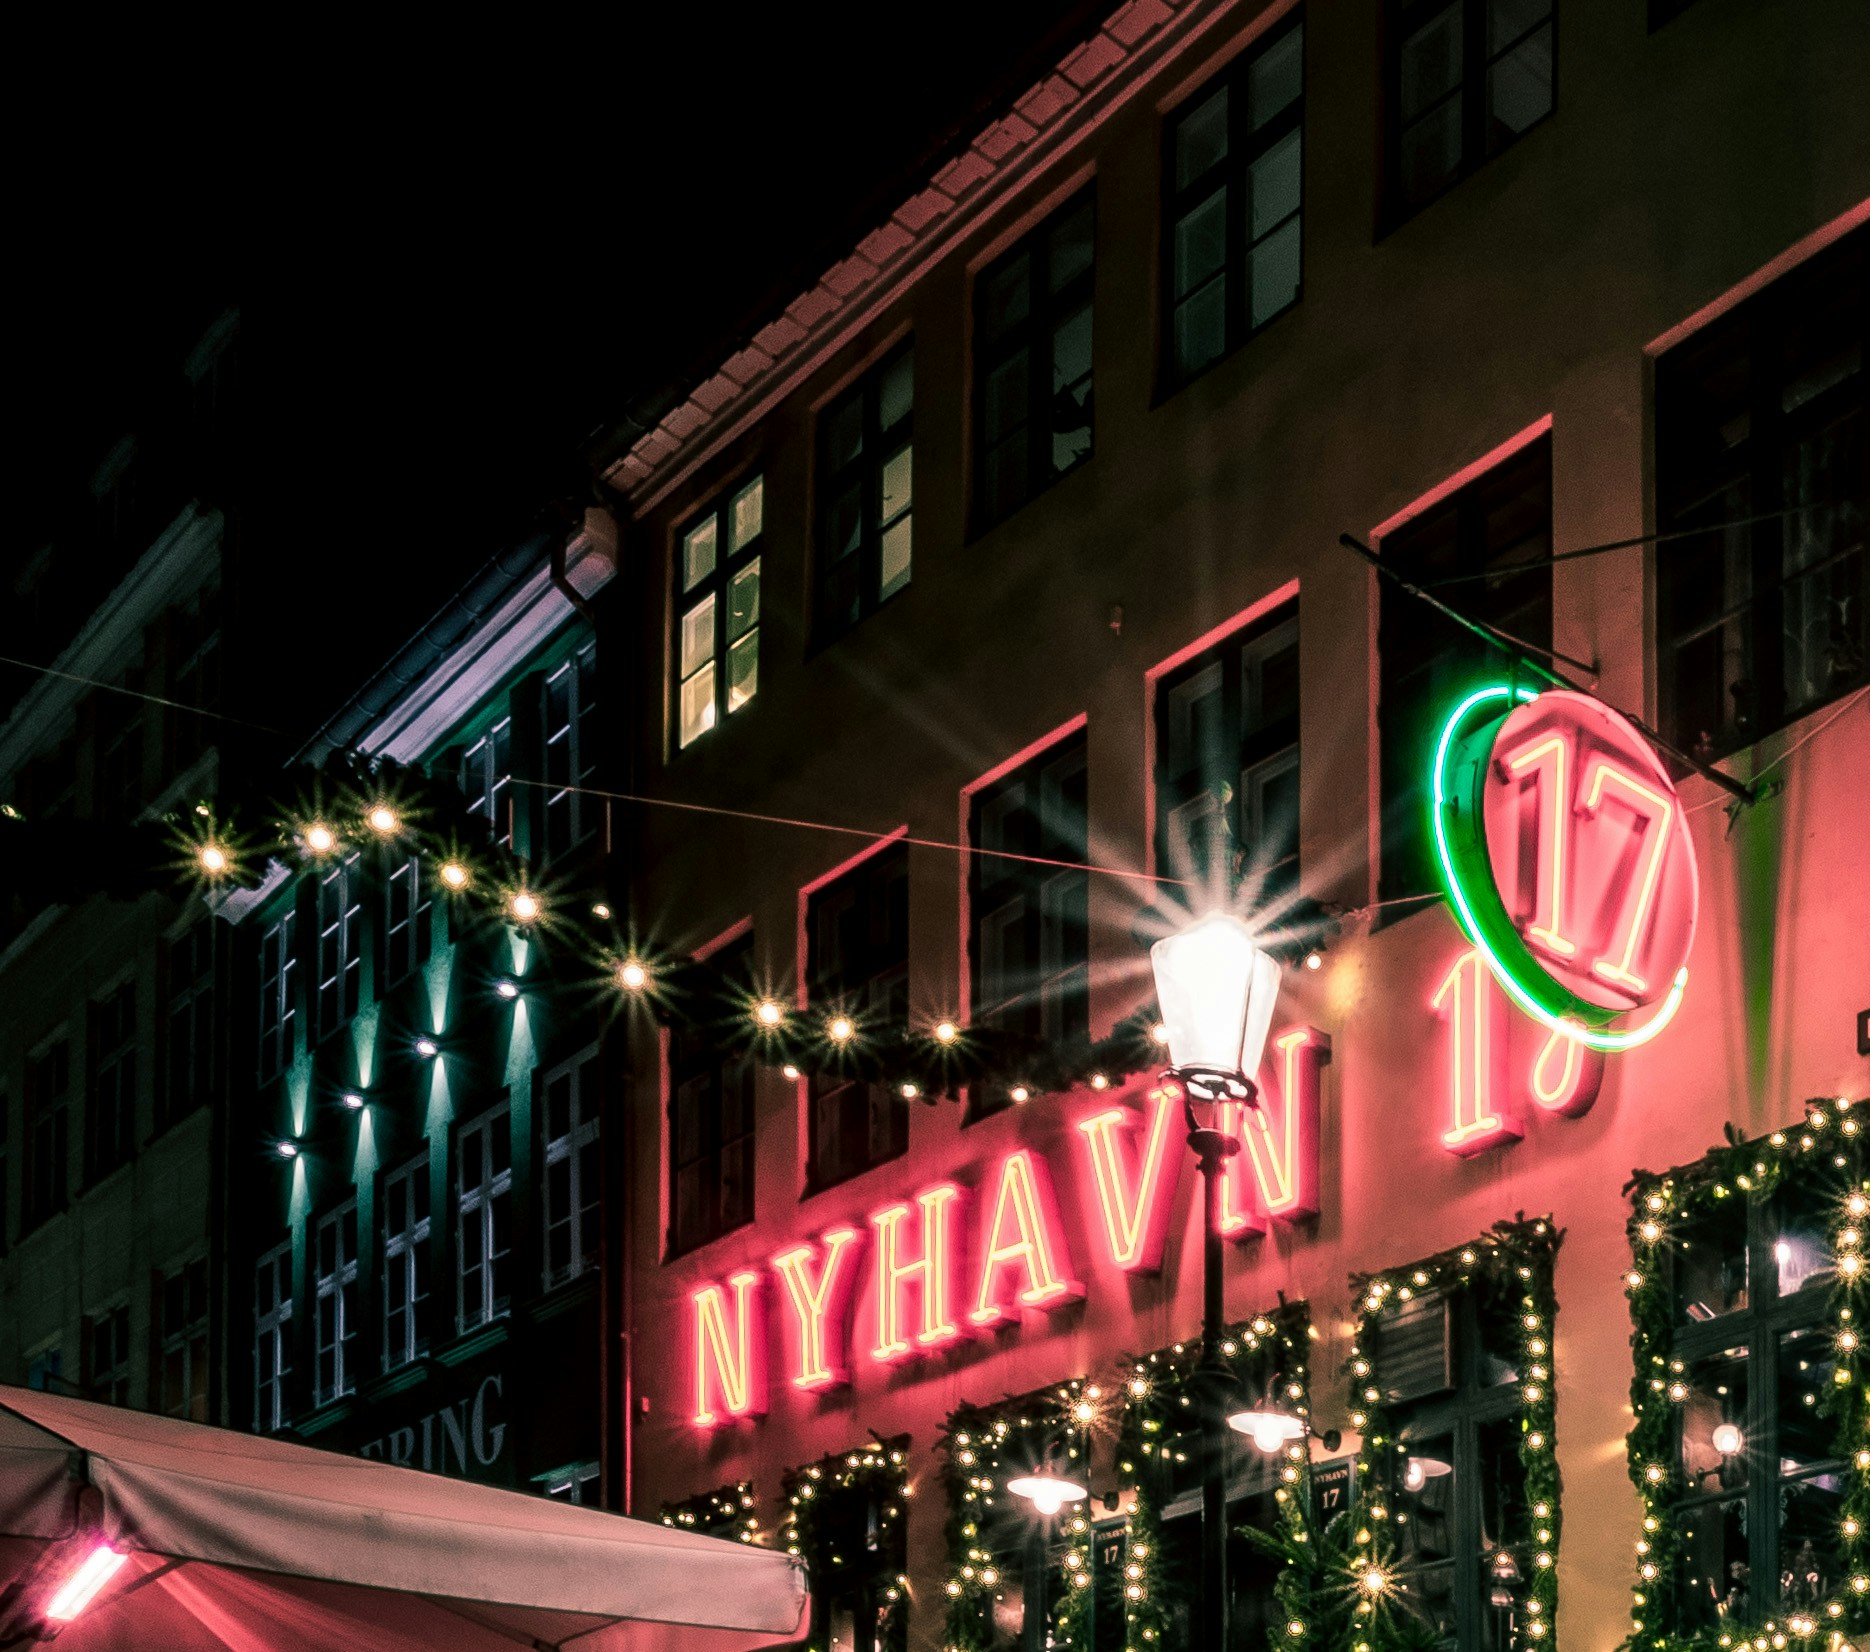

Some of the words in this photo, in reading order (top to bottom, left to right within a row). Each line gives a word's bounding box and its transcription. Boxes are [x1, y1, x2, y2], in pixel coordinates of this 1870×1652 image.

[1503, 735, 1674, 992] 17
[691, 1027, 1320, 1427] NYHAVN
[1104, 1544, 1119, 1565] 17
[1323, 1487, 1341, 1509] 17
